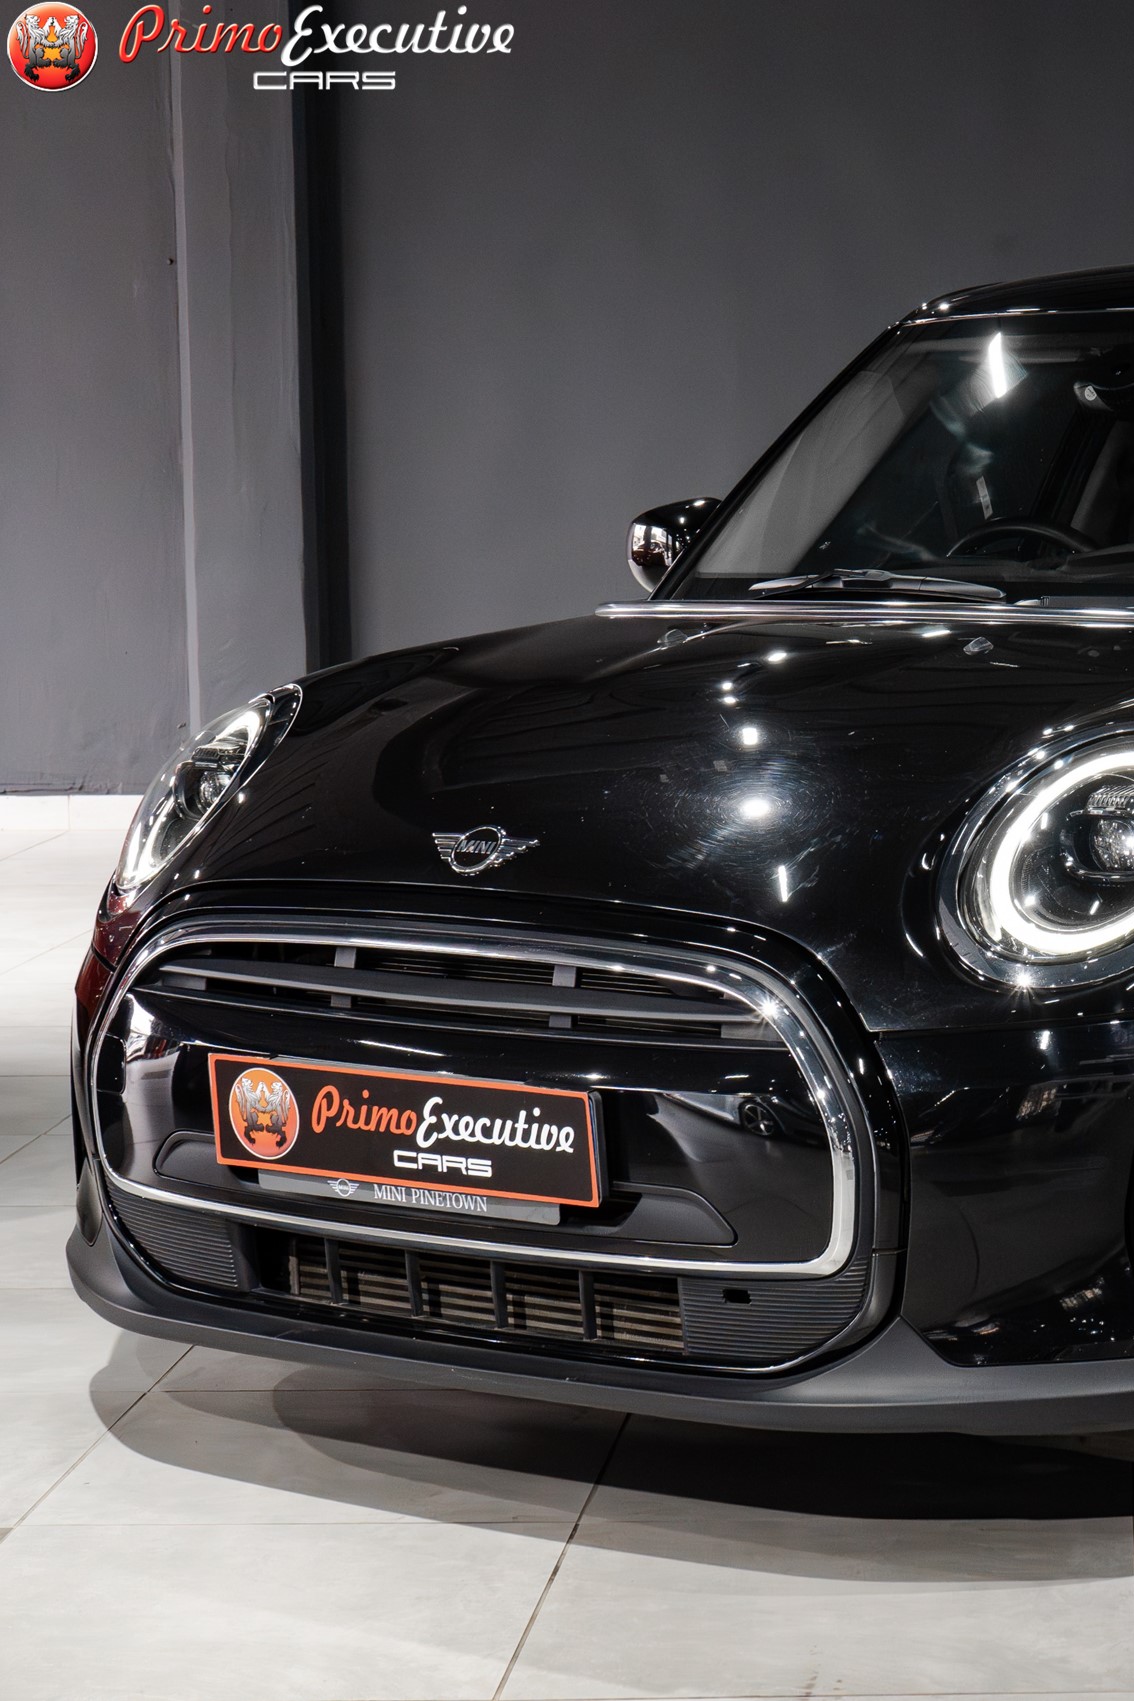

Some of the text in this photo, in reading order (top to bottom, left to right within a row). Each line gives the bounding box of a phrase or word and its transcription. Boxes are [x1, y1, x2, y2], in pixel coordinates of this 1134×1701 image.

[457, 840, 496, 855] MINI
[393, 1149, 492, 1178] CARS
[373, 1184, 488, 1213] MINI PINETOWN
